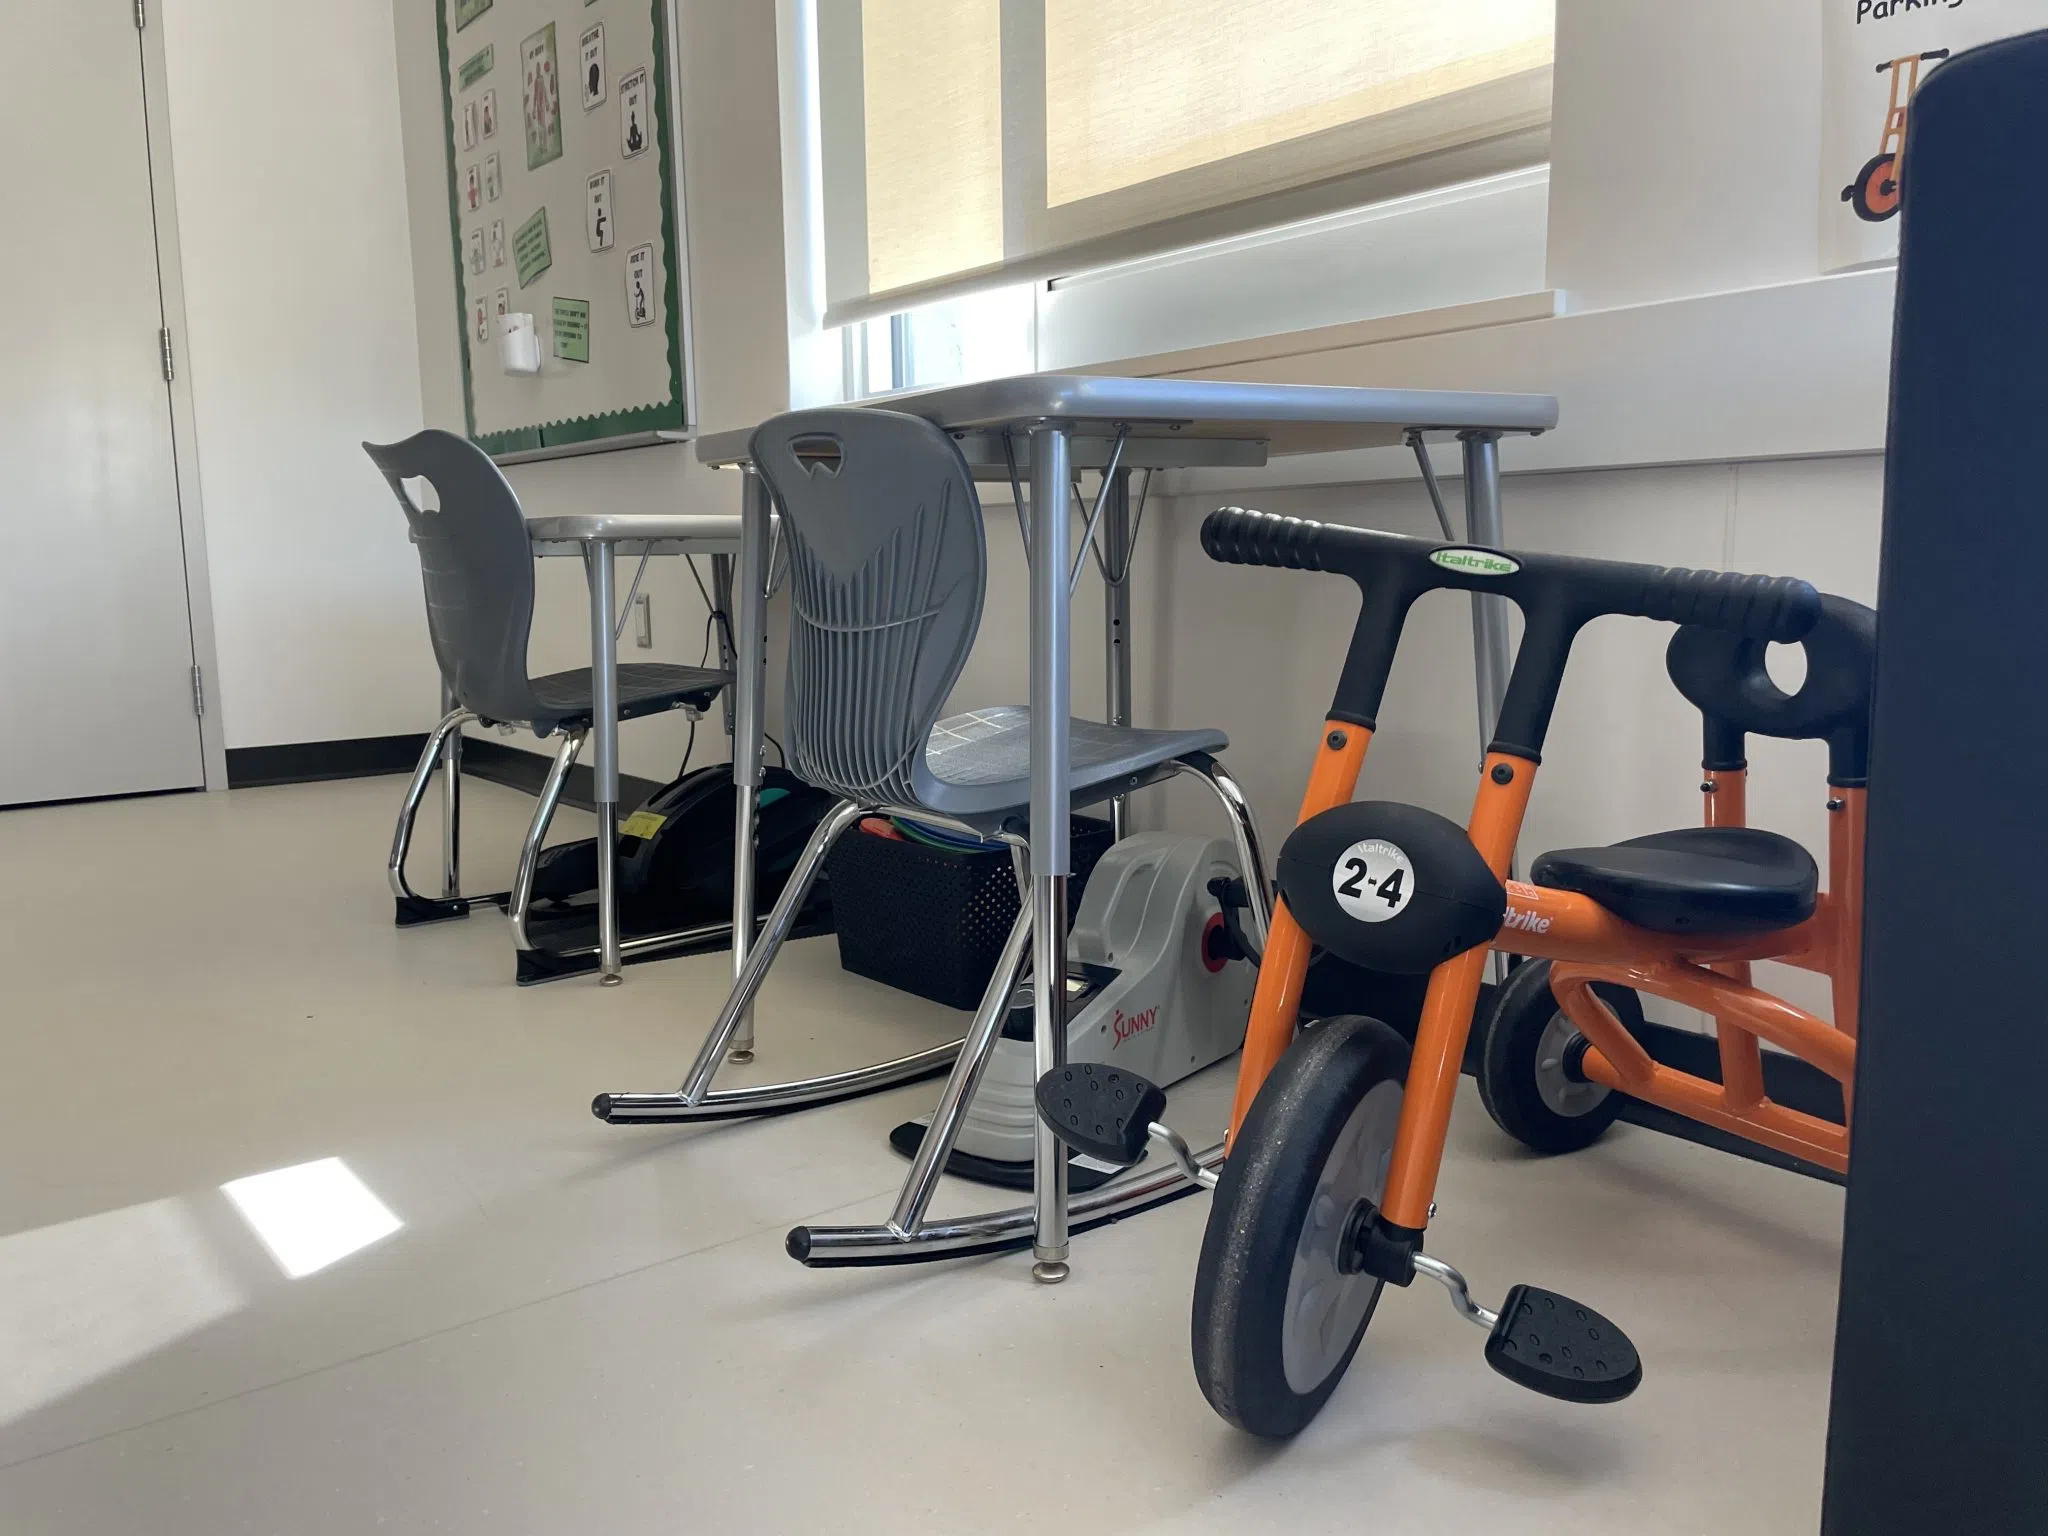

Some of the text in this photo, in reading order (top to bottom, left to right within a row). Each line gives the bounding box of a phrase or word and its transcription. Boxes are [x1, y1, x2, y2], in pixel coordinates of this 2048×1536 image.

[1857, 0, 1963, 25] Park
[1357, 842, 1404, 864] Italtrike
[1338, 857, 1405, 908] 2-4
[1503, 906, 1551, 934] ltrike
[1113, 1006, 1157, 1050] SUNNY
